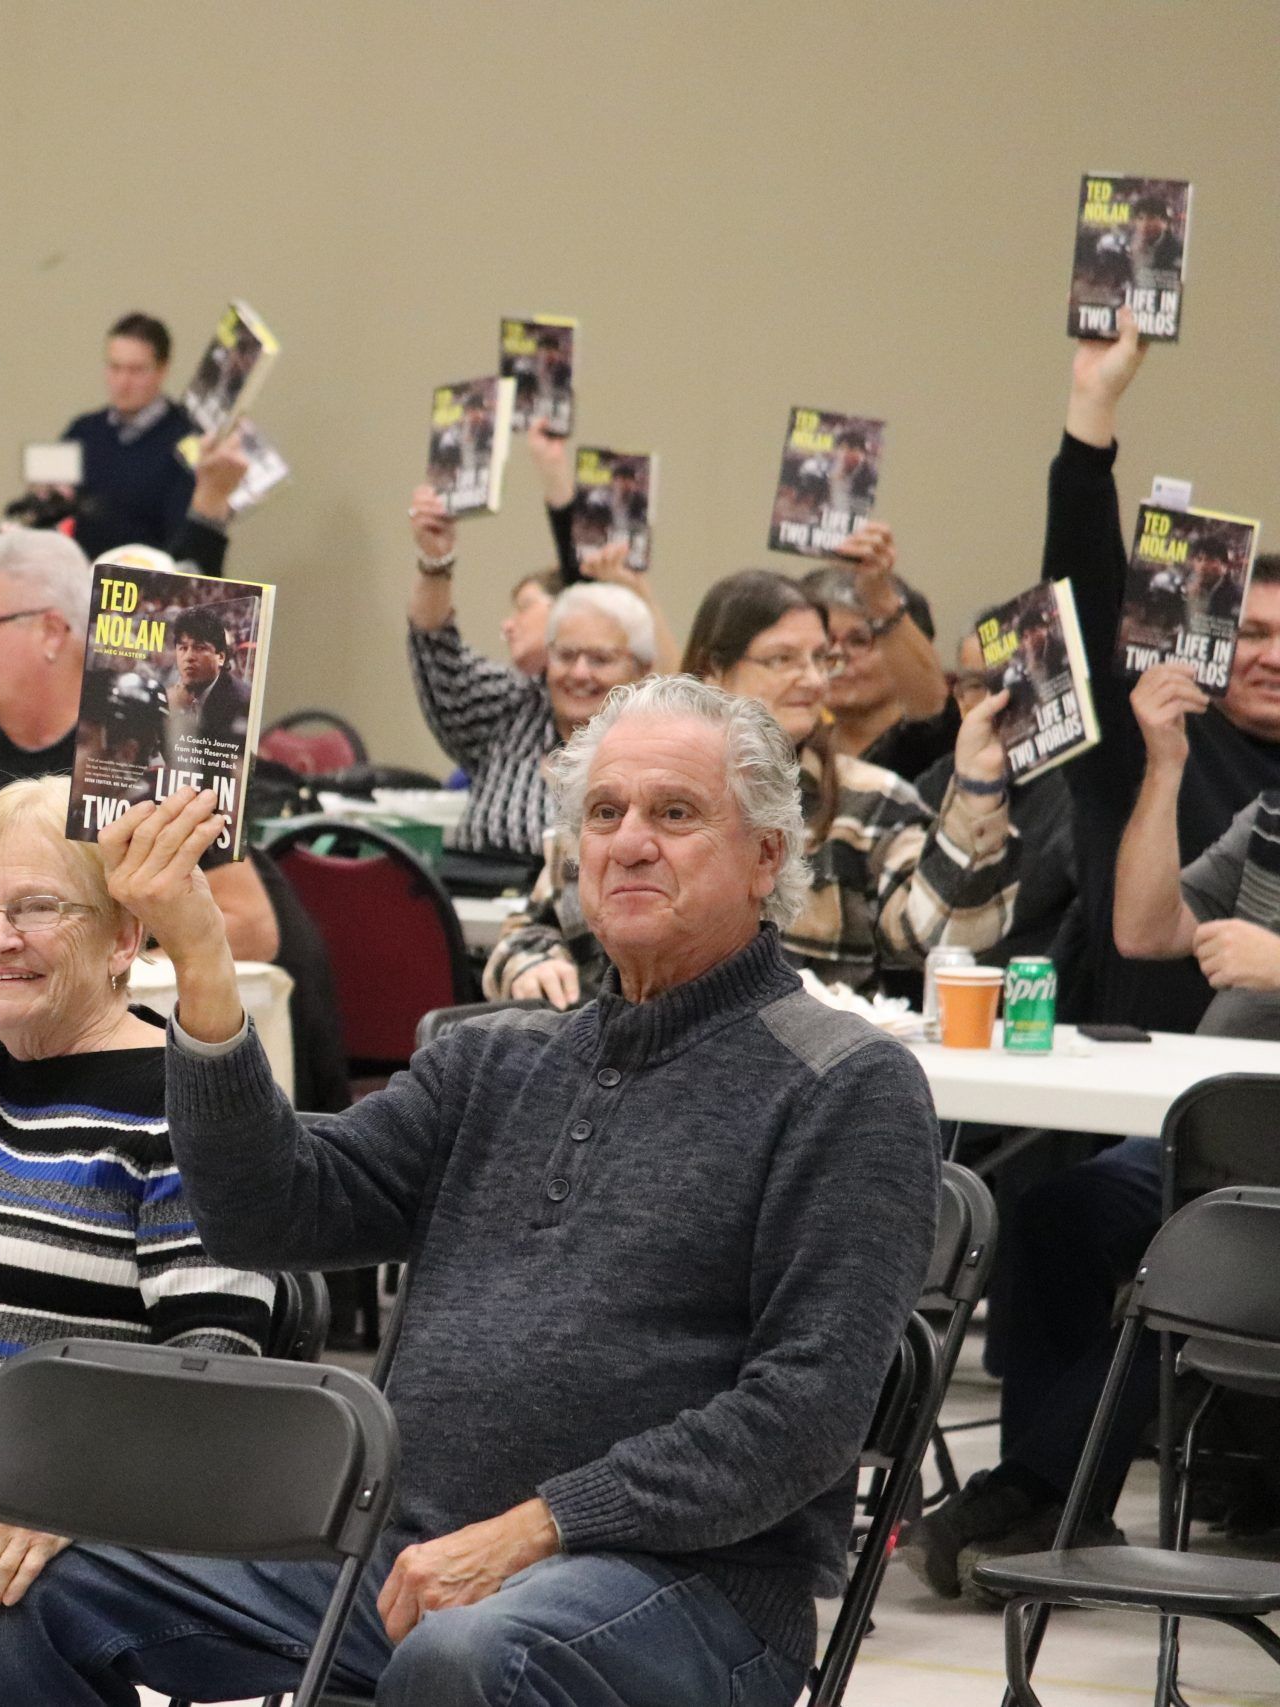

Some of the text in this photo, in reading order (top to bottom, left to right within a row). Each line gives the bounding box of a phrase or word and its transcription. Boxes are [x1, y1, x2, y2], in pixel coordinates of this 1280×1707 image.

[1086, 180, 1112, 203] TED
[1084, 202, 1131, 225] NOLAN
[1160, 289, 1179, 315] IN
[1078, 306, 1112, 331] TWO
[1144, 511, 1171, 536] TED
[1139, 534, 1188, 563] NOLAN
[100, 578, 139, 613] TED
[94, 613, 166, 653] NOLAN
[978, 617, 1001, 646] TED
[1175, 630, 1233, 665] LIFE IN
[1035, 690, 1079, 732] LIFE IN
[174, 743, 190, 753] from
[191, 746, 203, 755] the
[204, 748, 230, 759] Reserve
[179, 734, 239, 752] A Coach's Journey
[1008, 716, 1083, 773] TWO WORLDS
[177, 755, 237, 770] the NHL and Back
[155, 767, 204, 802] LIFE
[213, 775, 236, 812] IN
[82, 794, 131, 831] TWO
